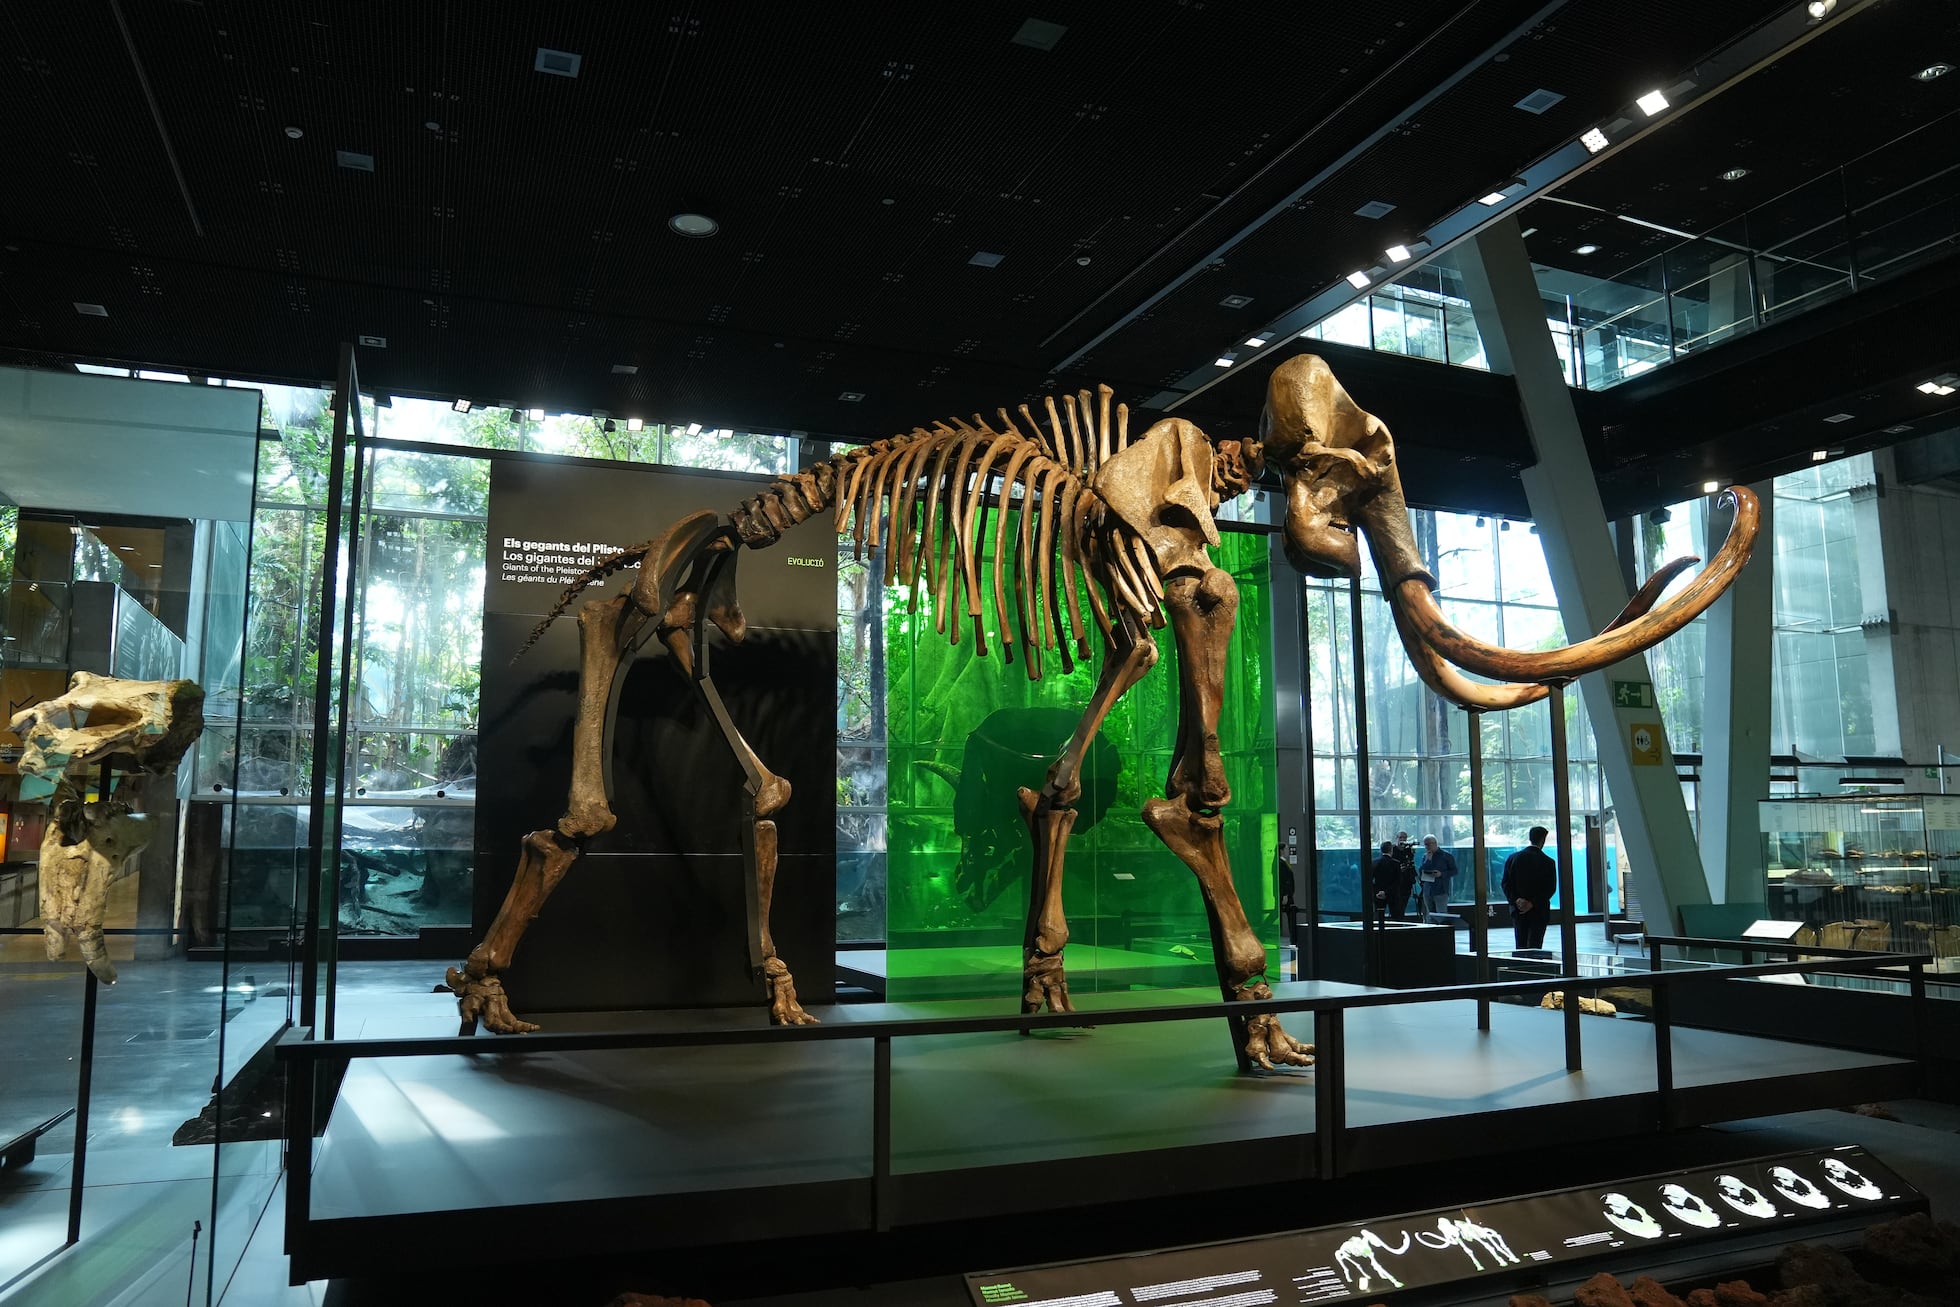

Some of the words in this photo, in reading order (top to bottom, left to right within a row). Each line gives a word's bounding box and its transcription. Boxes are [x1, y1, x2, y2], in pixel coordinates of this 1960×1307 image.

[503, 537, 522, 549] Els
[522, 541, 571, 553] gegants
[572, 542, 592, 554] del
[592, 543, 625, 555] Plisto
[503, 550, 524, 561] Los
[525, 552, 575, 565] gigantes
[577, 555, 595, 566] del
[787, 557, 825, 568] EVOLUCIÓ
[502, 562, 529, 572] Giants
[530, 564, 540, 573] of
[541, 564, 555, 574] the
[501, 572, 517, 581] Les
[517, 573, 546, 583] géants
[546, 575, 558, 584] du
